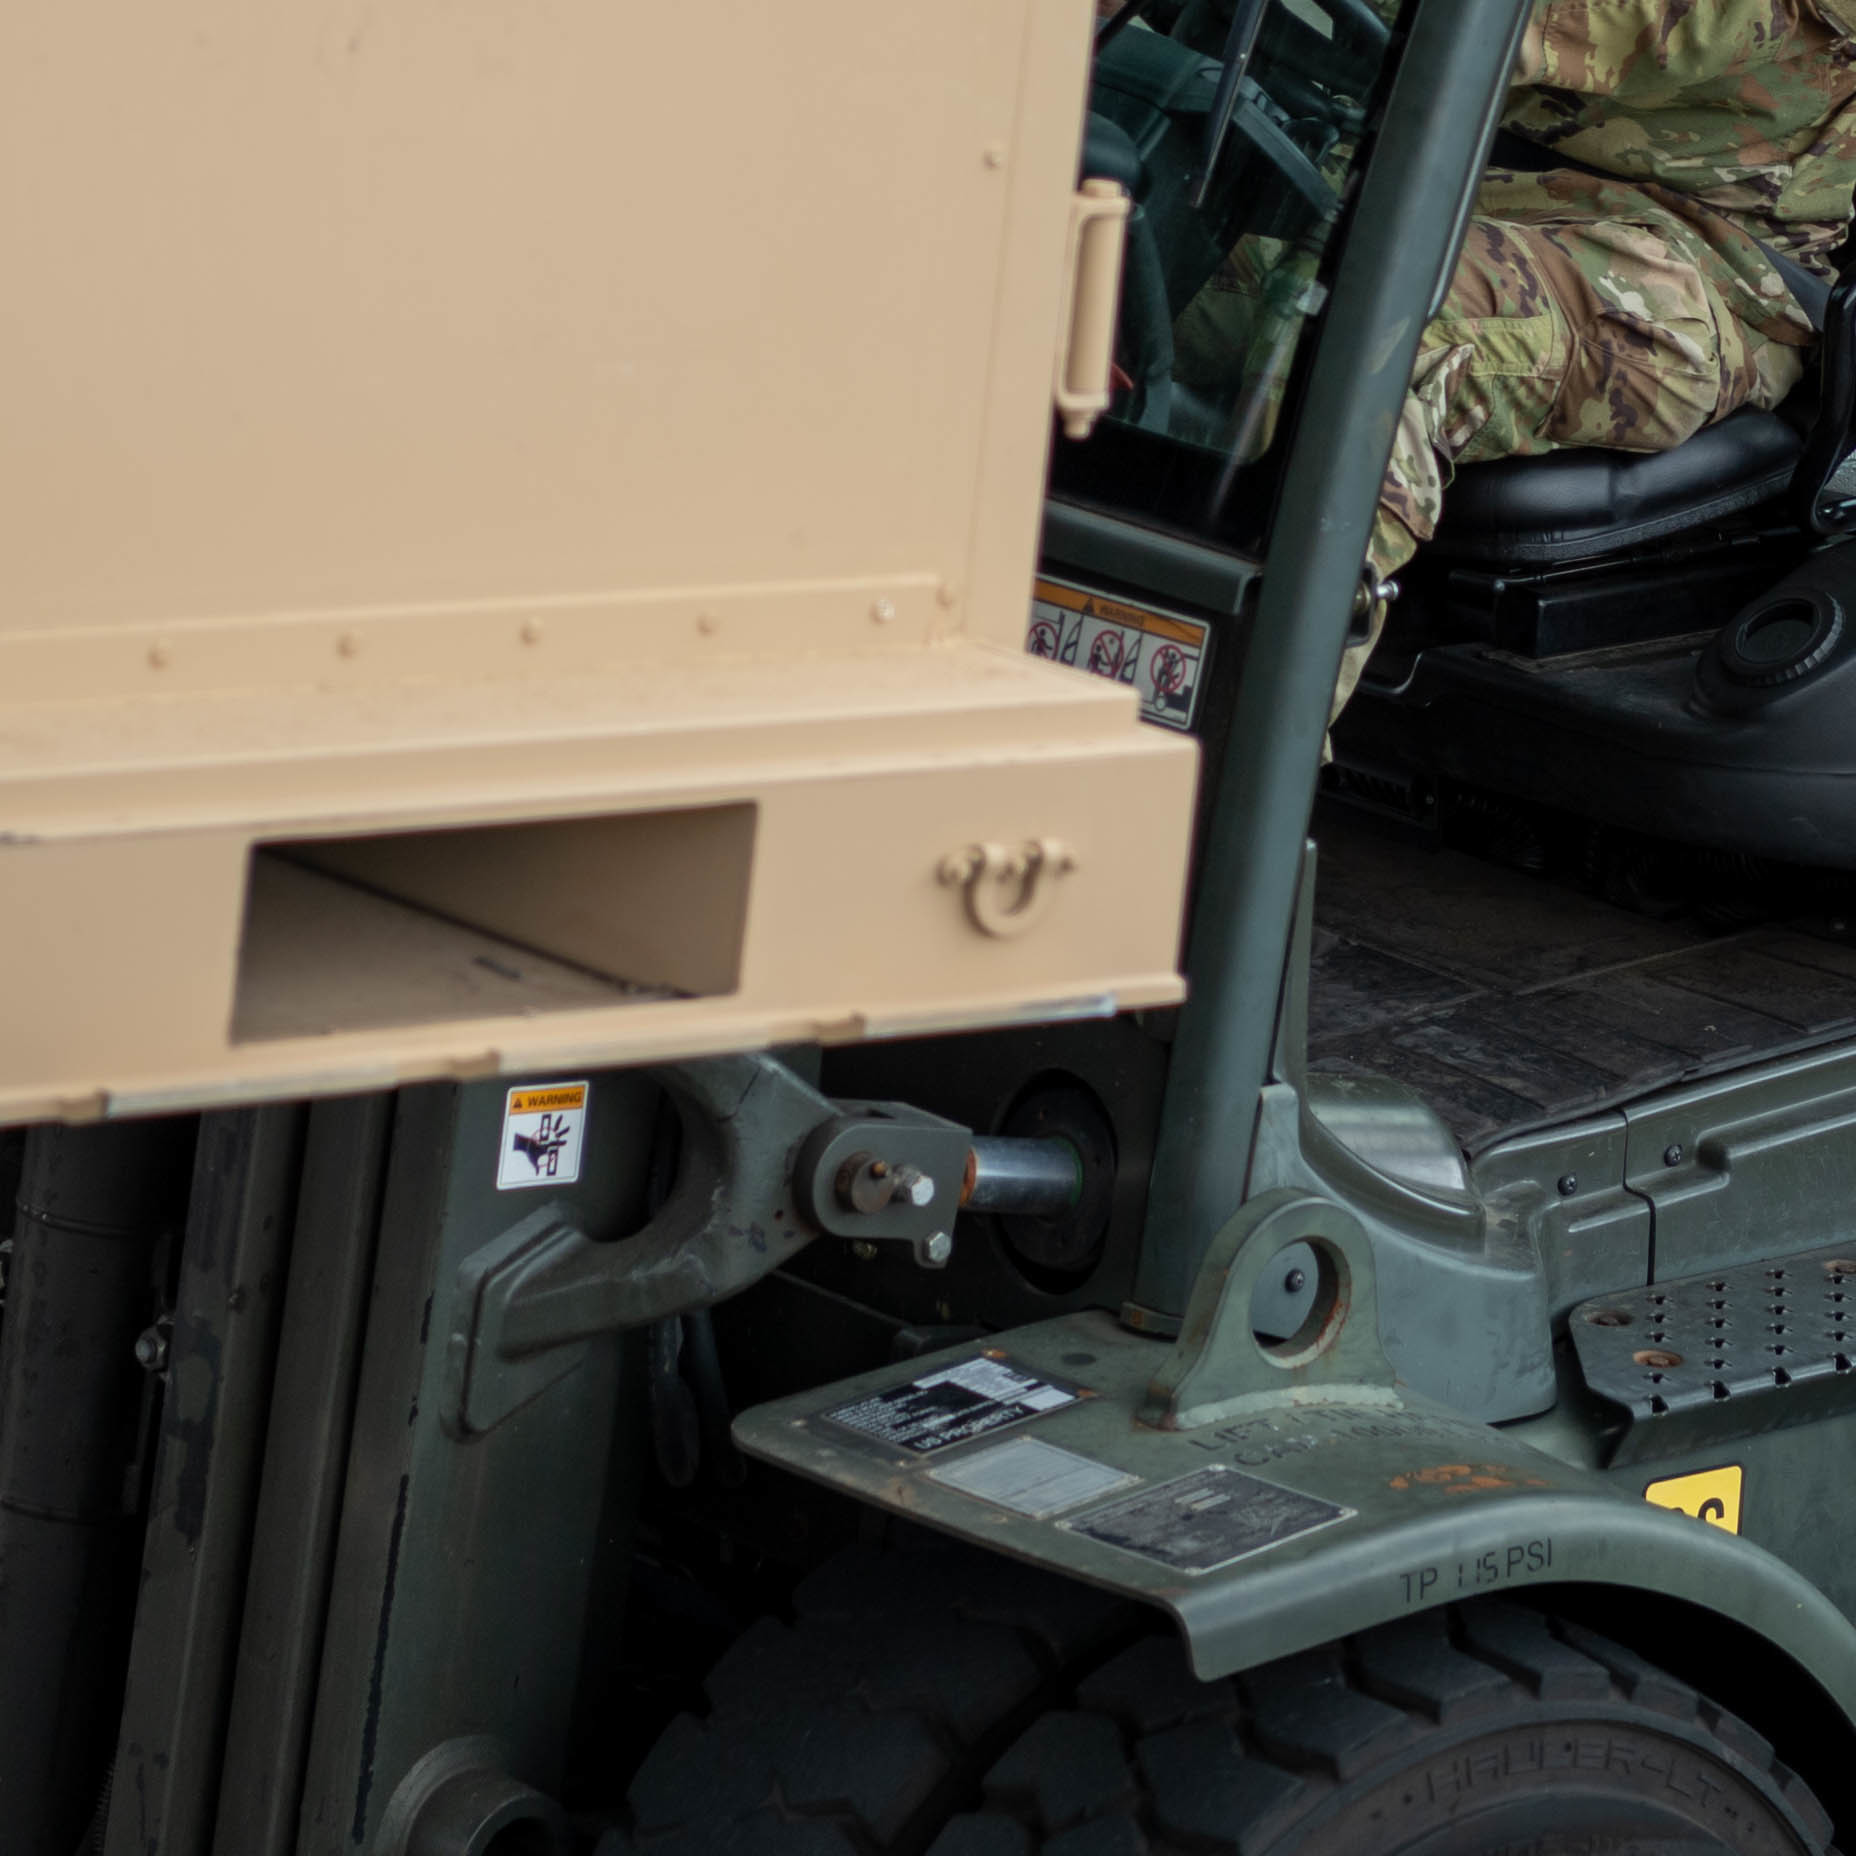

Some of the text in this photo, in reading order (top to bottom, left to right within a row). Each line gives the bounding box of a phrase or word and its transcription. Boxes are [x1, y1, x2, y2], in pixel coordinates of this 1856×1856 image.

[527, 1091, 582, 1107] WARNING
[1399, 1536, 1553, 1603] TP 115 PSI
